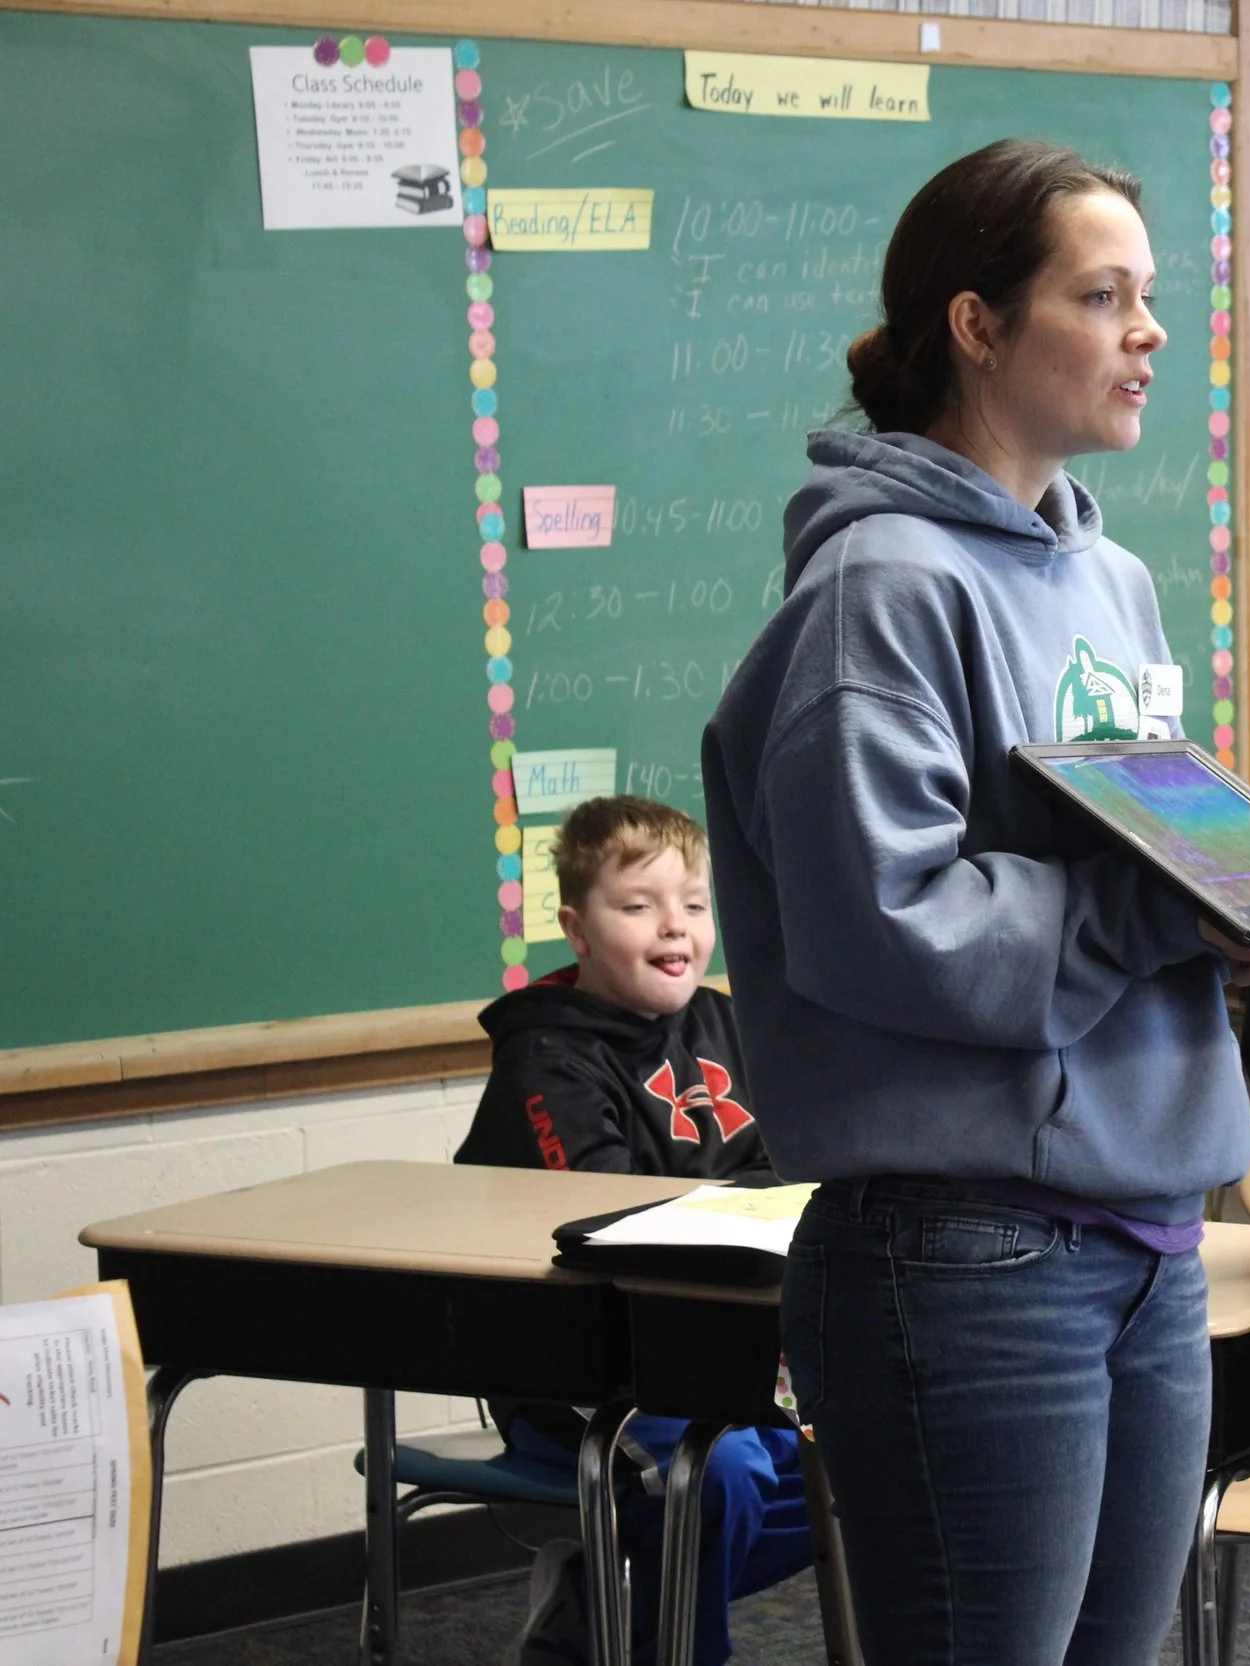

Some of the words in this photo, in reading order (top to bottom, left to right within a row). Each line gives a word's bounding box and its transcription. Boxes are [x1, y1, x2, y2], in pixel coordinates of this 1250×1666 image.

[292, 73, 337, 93] Class
[342, 73, 424, 93] Schedule
[700, 73, 754, 111] Today
[777, 91, 799, 109] we
[820, 84, 852, 110] will
[870, 85, 919, 112] learn
[493, 192, 636, 244] Reading/ELA
[532, 498, 602, 539] Spelling
[528, 761, 580, 796] Math
